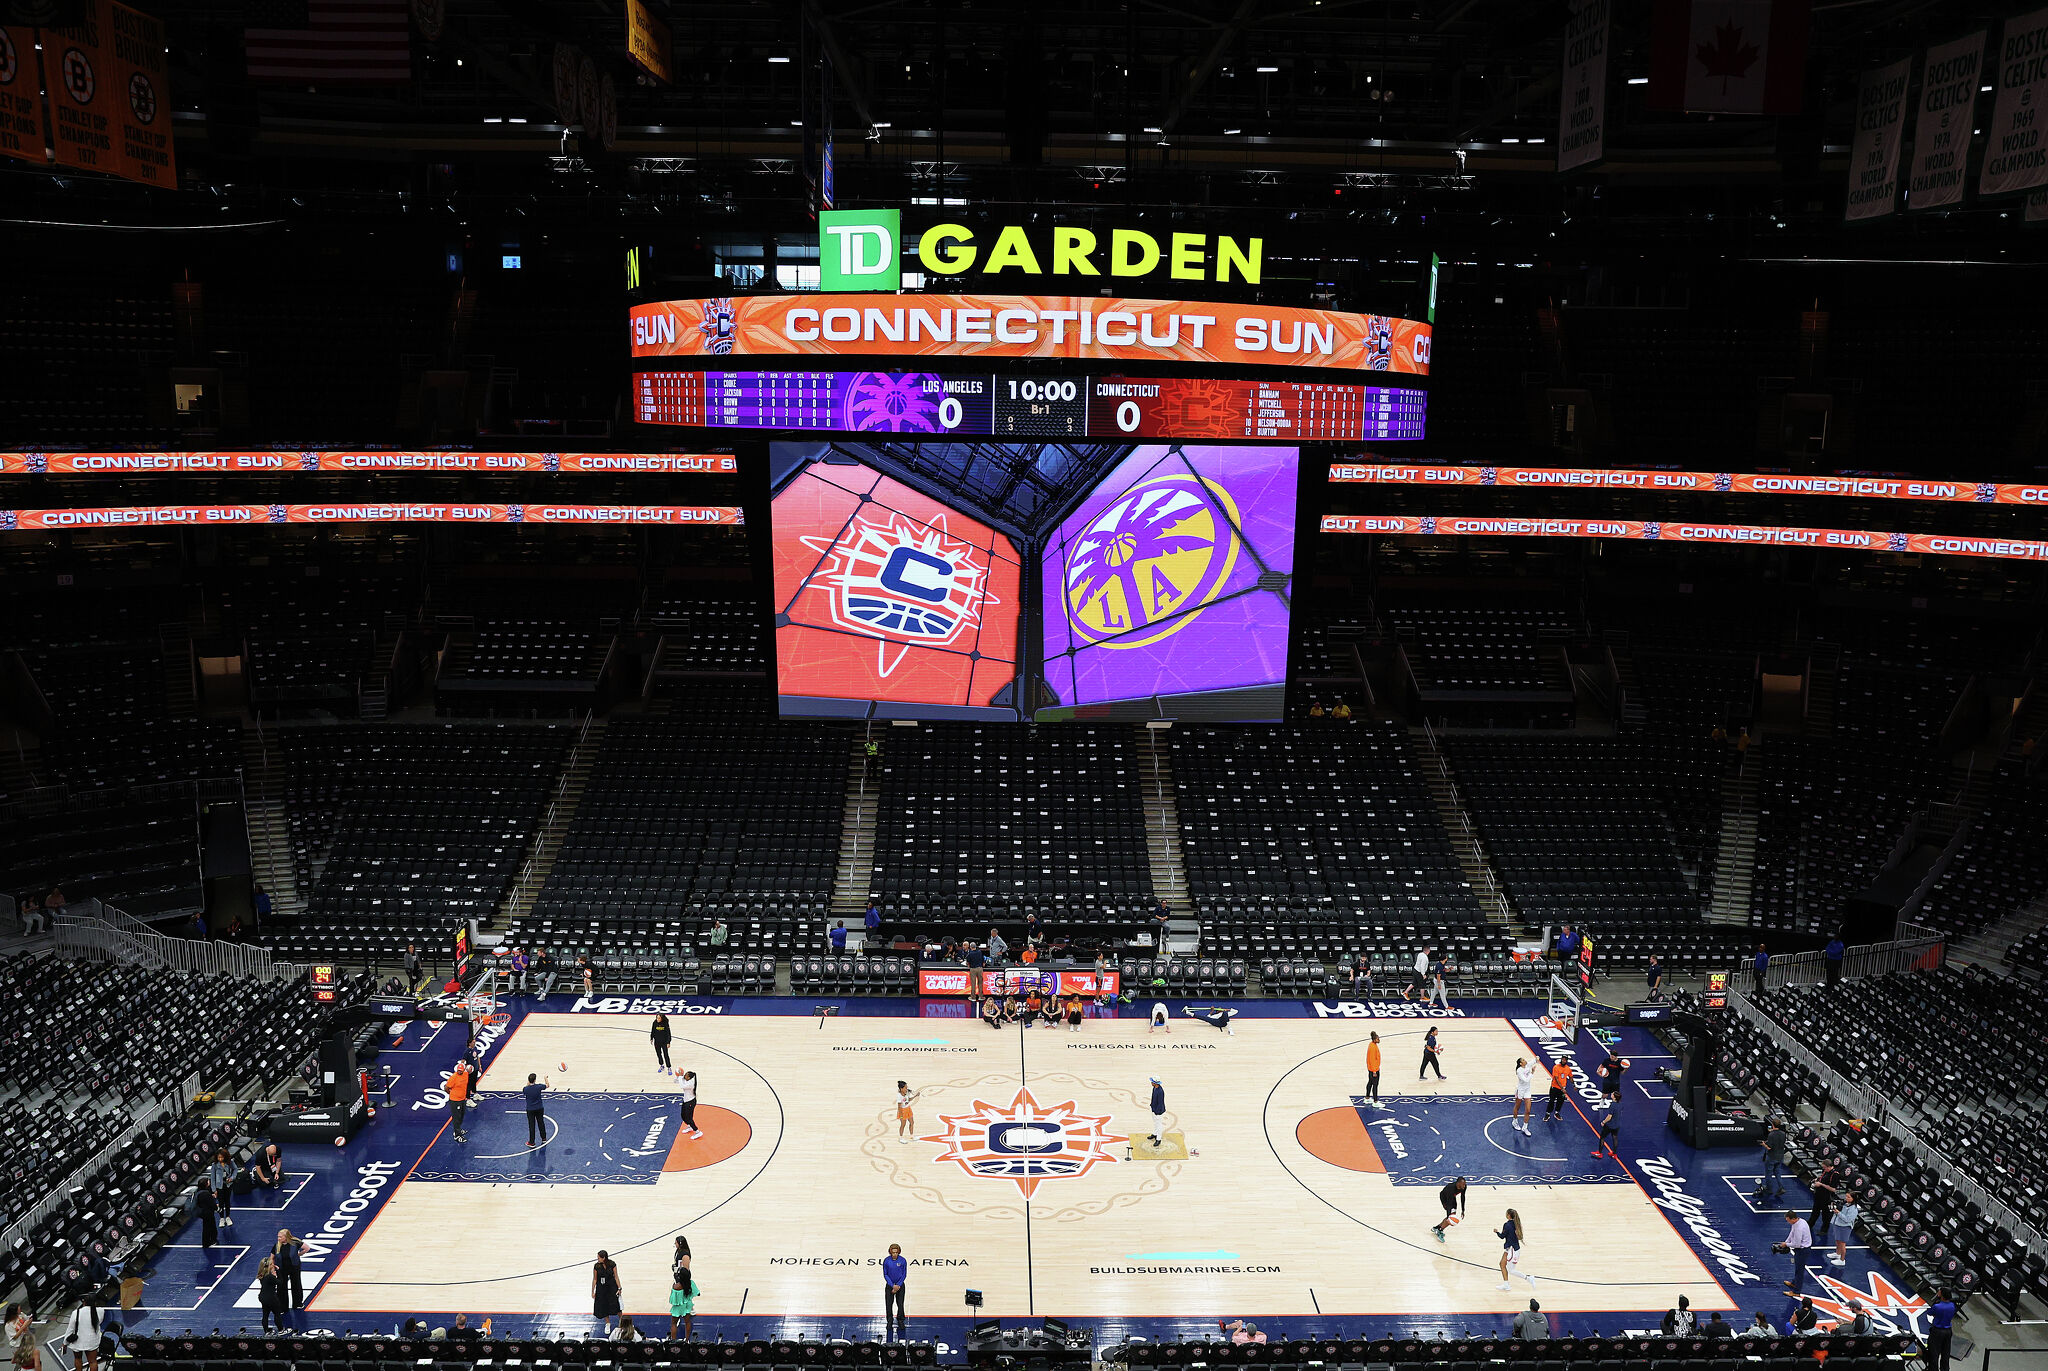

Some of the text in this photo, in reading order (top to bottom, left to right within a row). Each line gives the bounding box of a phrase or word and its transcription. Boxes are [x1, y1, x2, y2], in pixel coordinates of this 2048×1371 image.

[1928, 51, 1978, 87] BOSTON
[1926, 80, 1971, 112] CELTICS
[2013, 108, 2035, 130] 1969
[2002, 129, 2039, 154] WORLD
[1925, 151, 1955, 172] WORLD
[1989, 148, 2047, 176] CHAMPIONS
[1860, 167, 1887, 186] WORLD
[1912, 168, 1963, 193] CHAMPIONS
[1850, 182, 1894, 205] CHAMPIONS
[826, 223, 1263, 285] TD GARDEN
[636, 313, 676, 346] SUN
[786, 308, 1334, 355] CONNECTICUT SUN
[922, 380, 983, 395] LOS ANGELES
[1008, 380, 1077, 402] 10:00
[1096, 383, 1161, 398] CONNECTICUT
[938, 398, 963, 429] 0
[1031, 404, 1050, 415] Br1
[1116, 400, 1141, 433] 0
[72, 456, 283, 469] CONNECTICUT SUN
[341, 455, 526, 468] CONNECTICUT SUN
[579, 457, 714, 469] CONNECTICUT
[1424, 469, 1464, 481] SUN
[1515, 472, 1696, 487] CONNECTICUT SUN
[1752, 478, 1956, 498] CONNECTICUT SUN
[42, 509, 251, 525] CONNECTICUT SUN
[307, 507, 491, 520] CONNECTICUT SUN
[543, 508, 719, 521] CONNECTICUT SUN
[1365, 520, 1404, 531] SUN
[1454, 521, 1626, 535] CONNECTICUT SUN
[1680, 527, 1870, 546] CONNECTICUT SUN
[316, 974, 329, 983] 24
[926, 980, 967, 990] GAME
[1710, 981, 1723, 990] 24
[570, 997, 630, 1013] MB
[628, 1005, 723, 1014] BOSTON
[631, 998, 687, 1006] Meet
[1312, 1001, 1372, 1018] MB
[1367, 1002, 1423, 1010] Meet
[1372, 1008, 1466, 1018] BOSTON
[640, 1115, 669, 1150] WNBA
[1381, 1124, 1409, 1159] WNBA
[300, 1160, 402, 1263] Microsoft
[1635, 1156, 1761, 1285] Walgreens
[769, 1257, 969, 1267] MOHEGAN SU ARENA
[1090, 1265, 1281, 1274] BUILDSUBMARINES.COM
